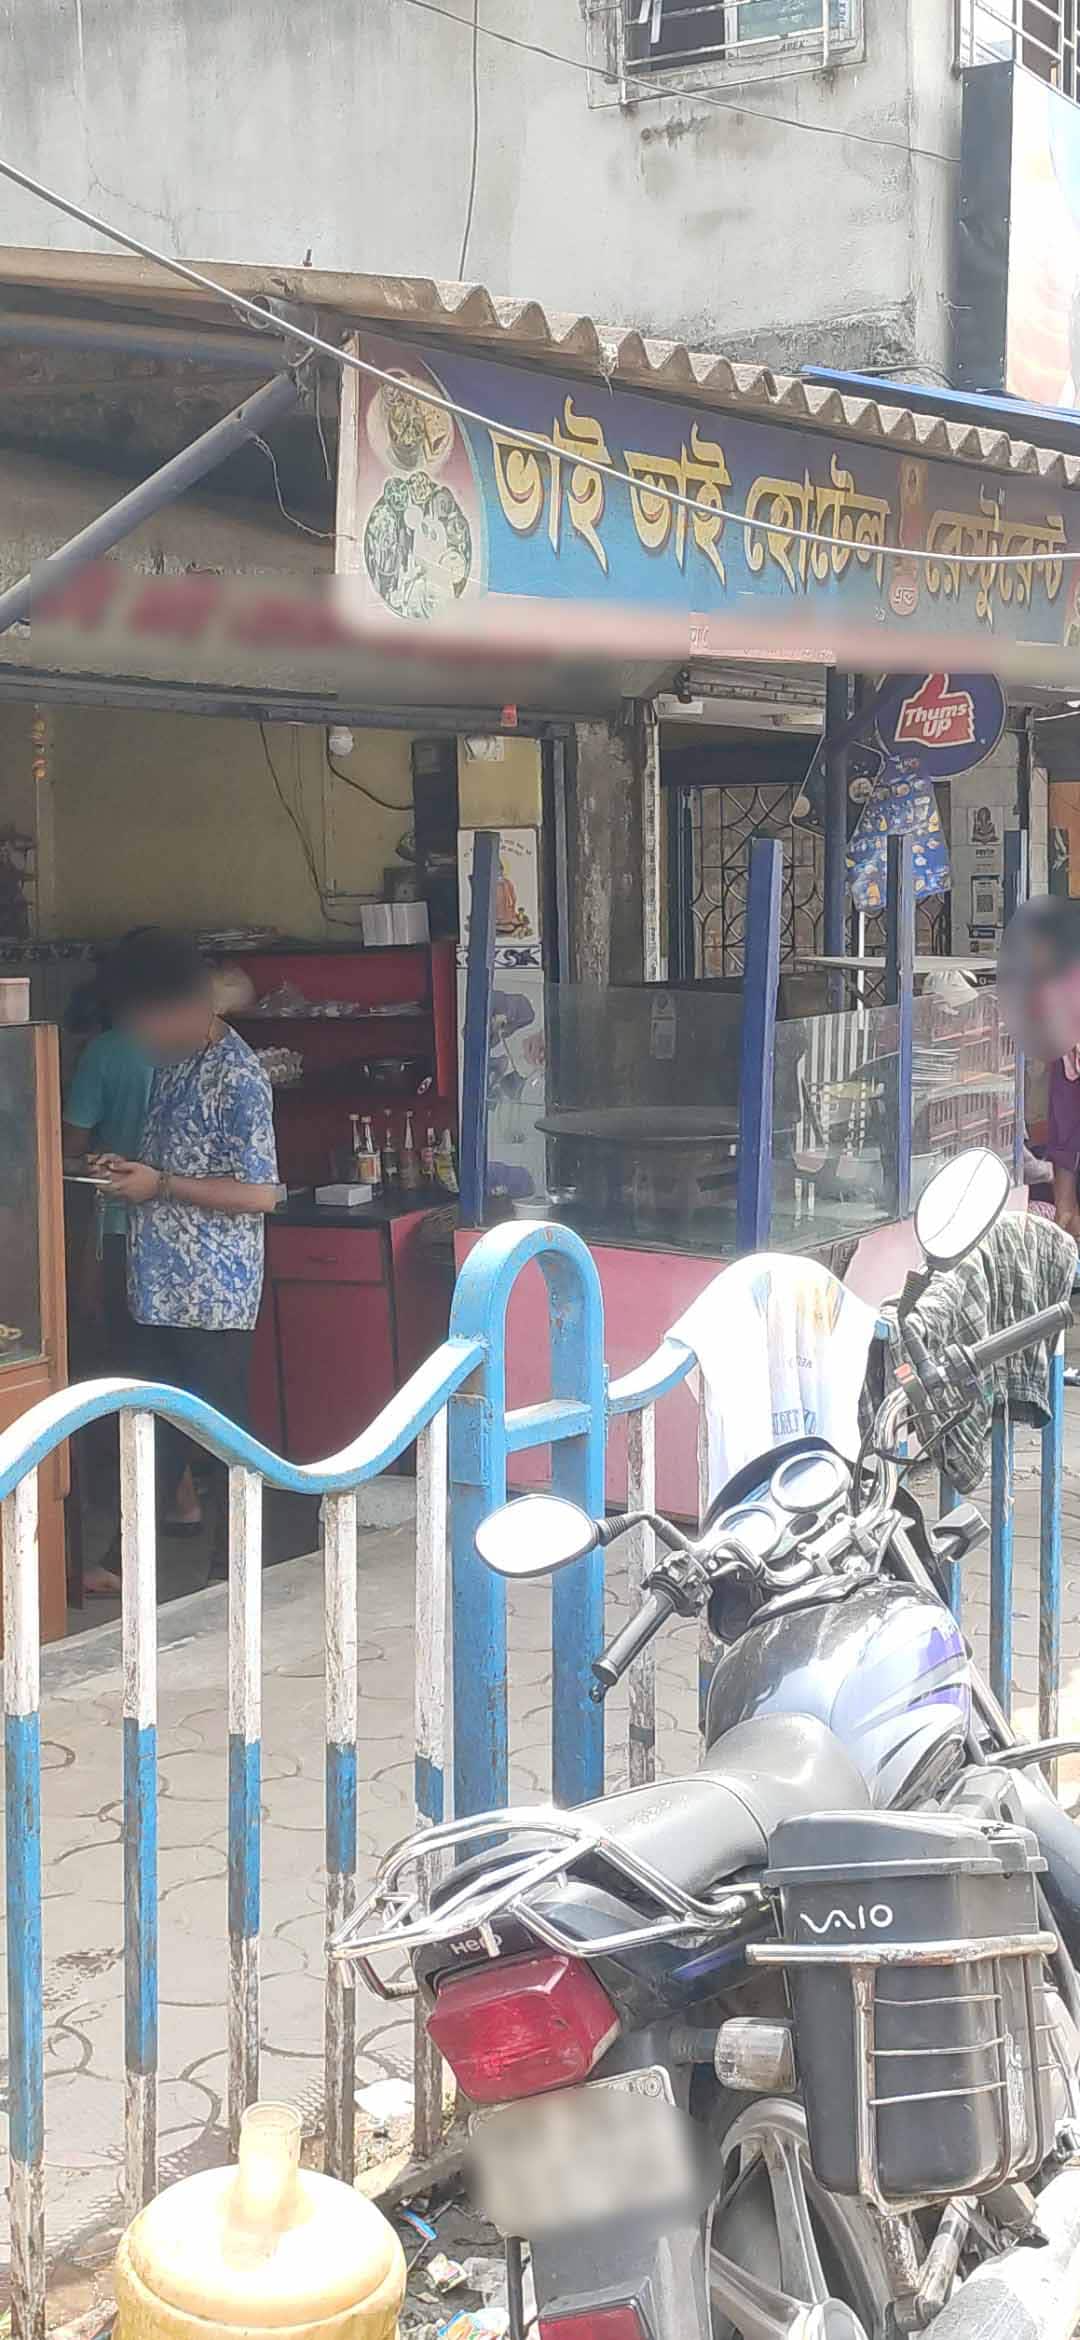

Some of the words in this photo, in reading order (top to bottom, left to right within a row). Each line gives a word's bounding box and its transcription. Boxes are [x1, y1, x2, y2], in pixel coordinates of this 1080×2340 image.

[488, 394, 612, 576] ভাই
[623, 420, 733, 588] ভাই
[744, 452, 891, 594] হোটেল
[904, 703, 968, 728] Thums
[799, 1903, 893, 1934] VAIO
